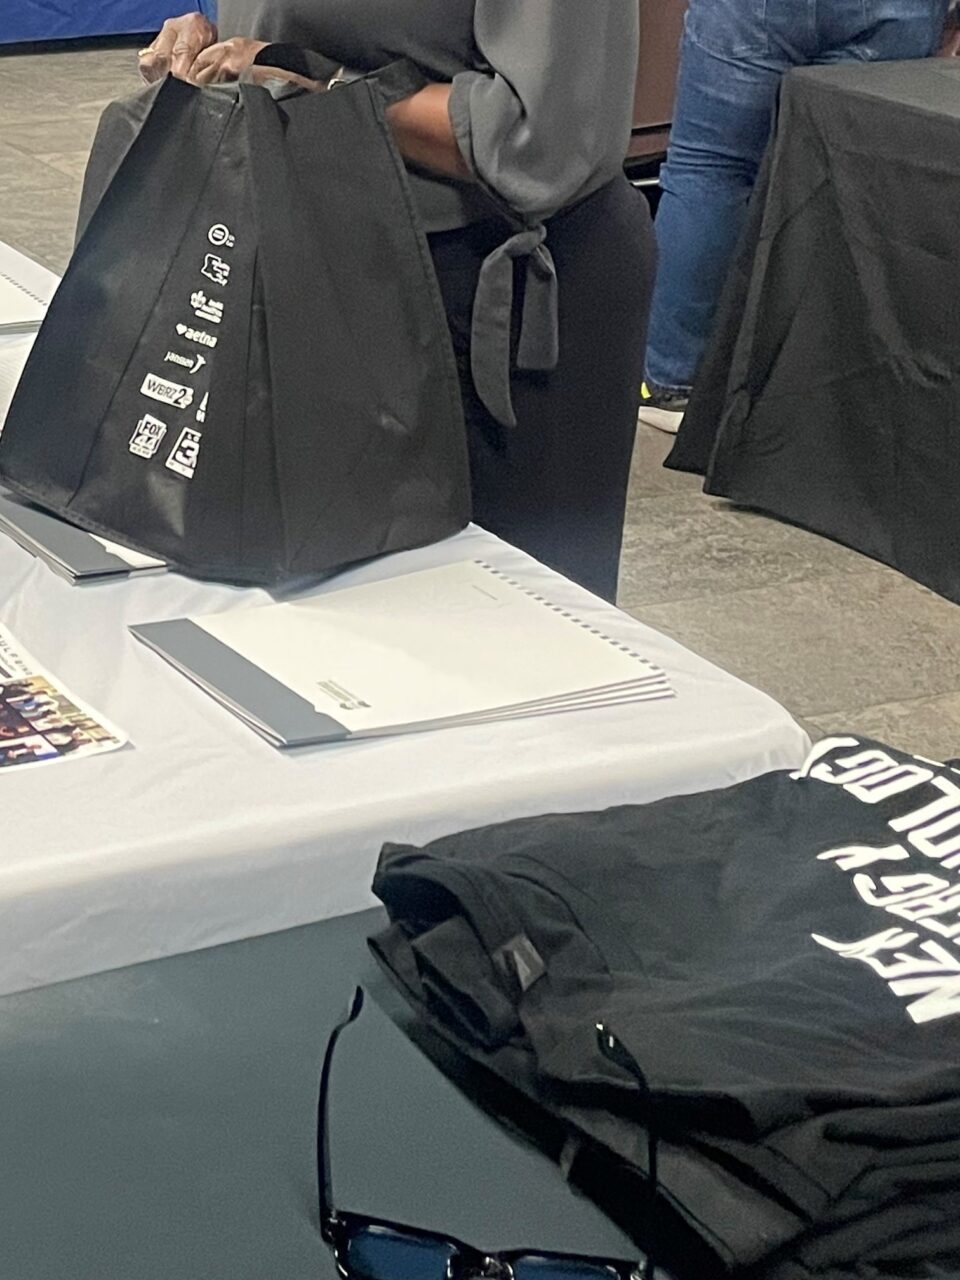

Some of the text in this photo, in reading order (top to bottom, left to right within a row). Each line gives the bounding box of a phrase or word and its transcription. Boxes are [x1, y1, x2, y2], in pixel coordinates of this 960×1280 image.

[185, 328, 218, 348] aetna
[146, 379, 188, 405] WBRZ 2
[143, 421, 163, 436] FOX
